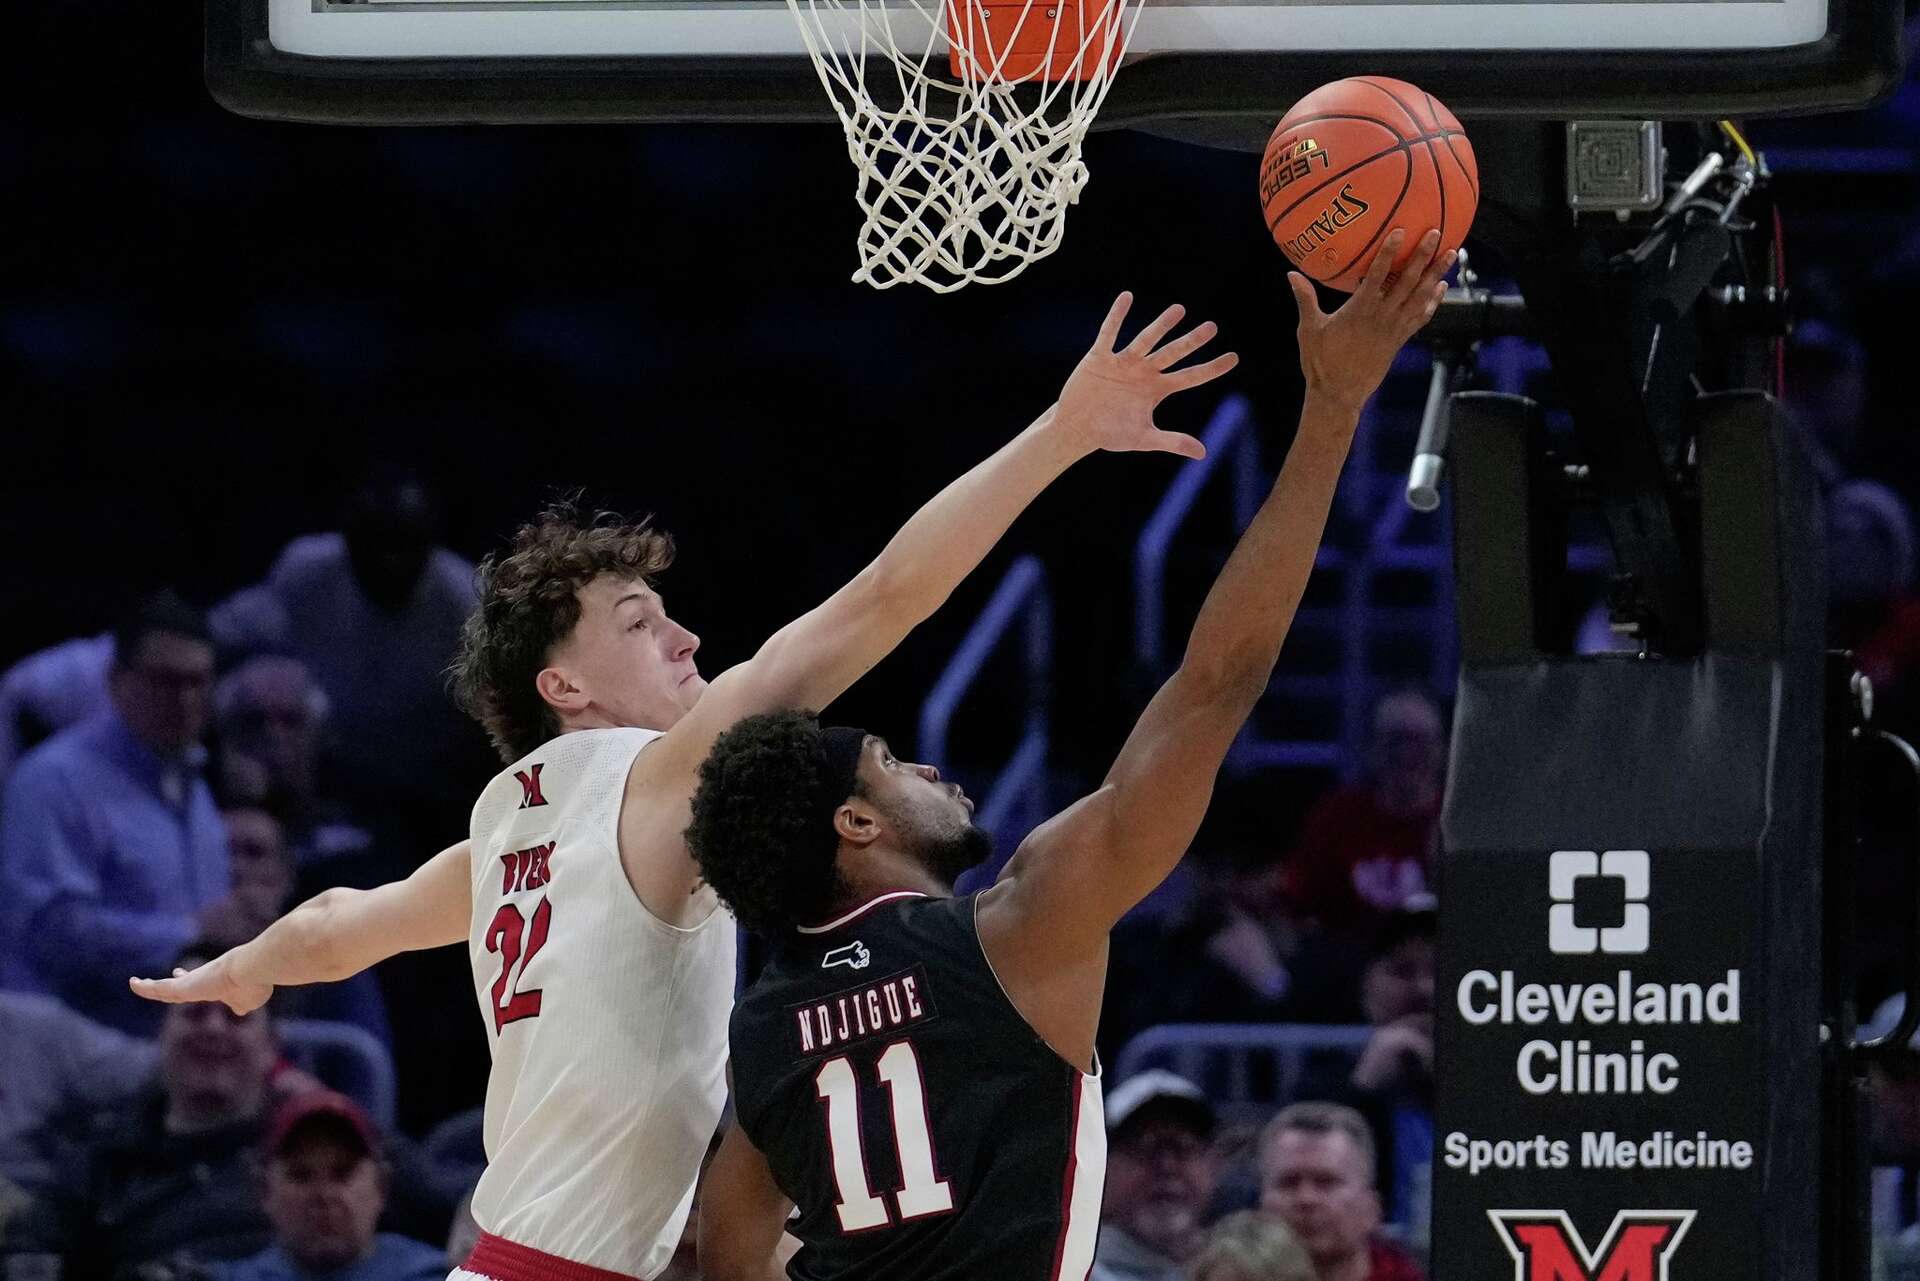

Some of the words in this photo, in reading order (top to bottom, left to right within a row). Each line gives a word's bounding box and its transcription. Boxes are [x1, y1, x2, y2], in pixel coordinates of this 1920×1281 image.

[797, 974, 924, 1053] NDJIGUE
[1457, 968, 1742, 1026] Cleveland
[1516, 1038, 1681, 1095] Clinic
[814, 1039, 955, 1234] 11
[1443, 1131, 1570, 1175] Sports
[1580, 1131, 1754, 1169] Medicine
